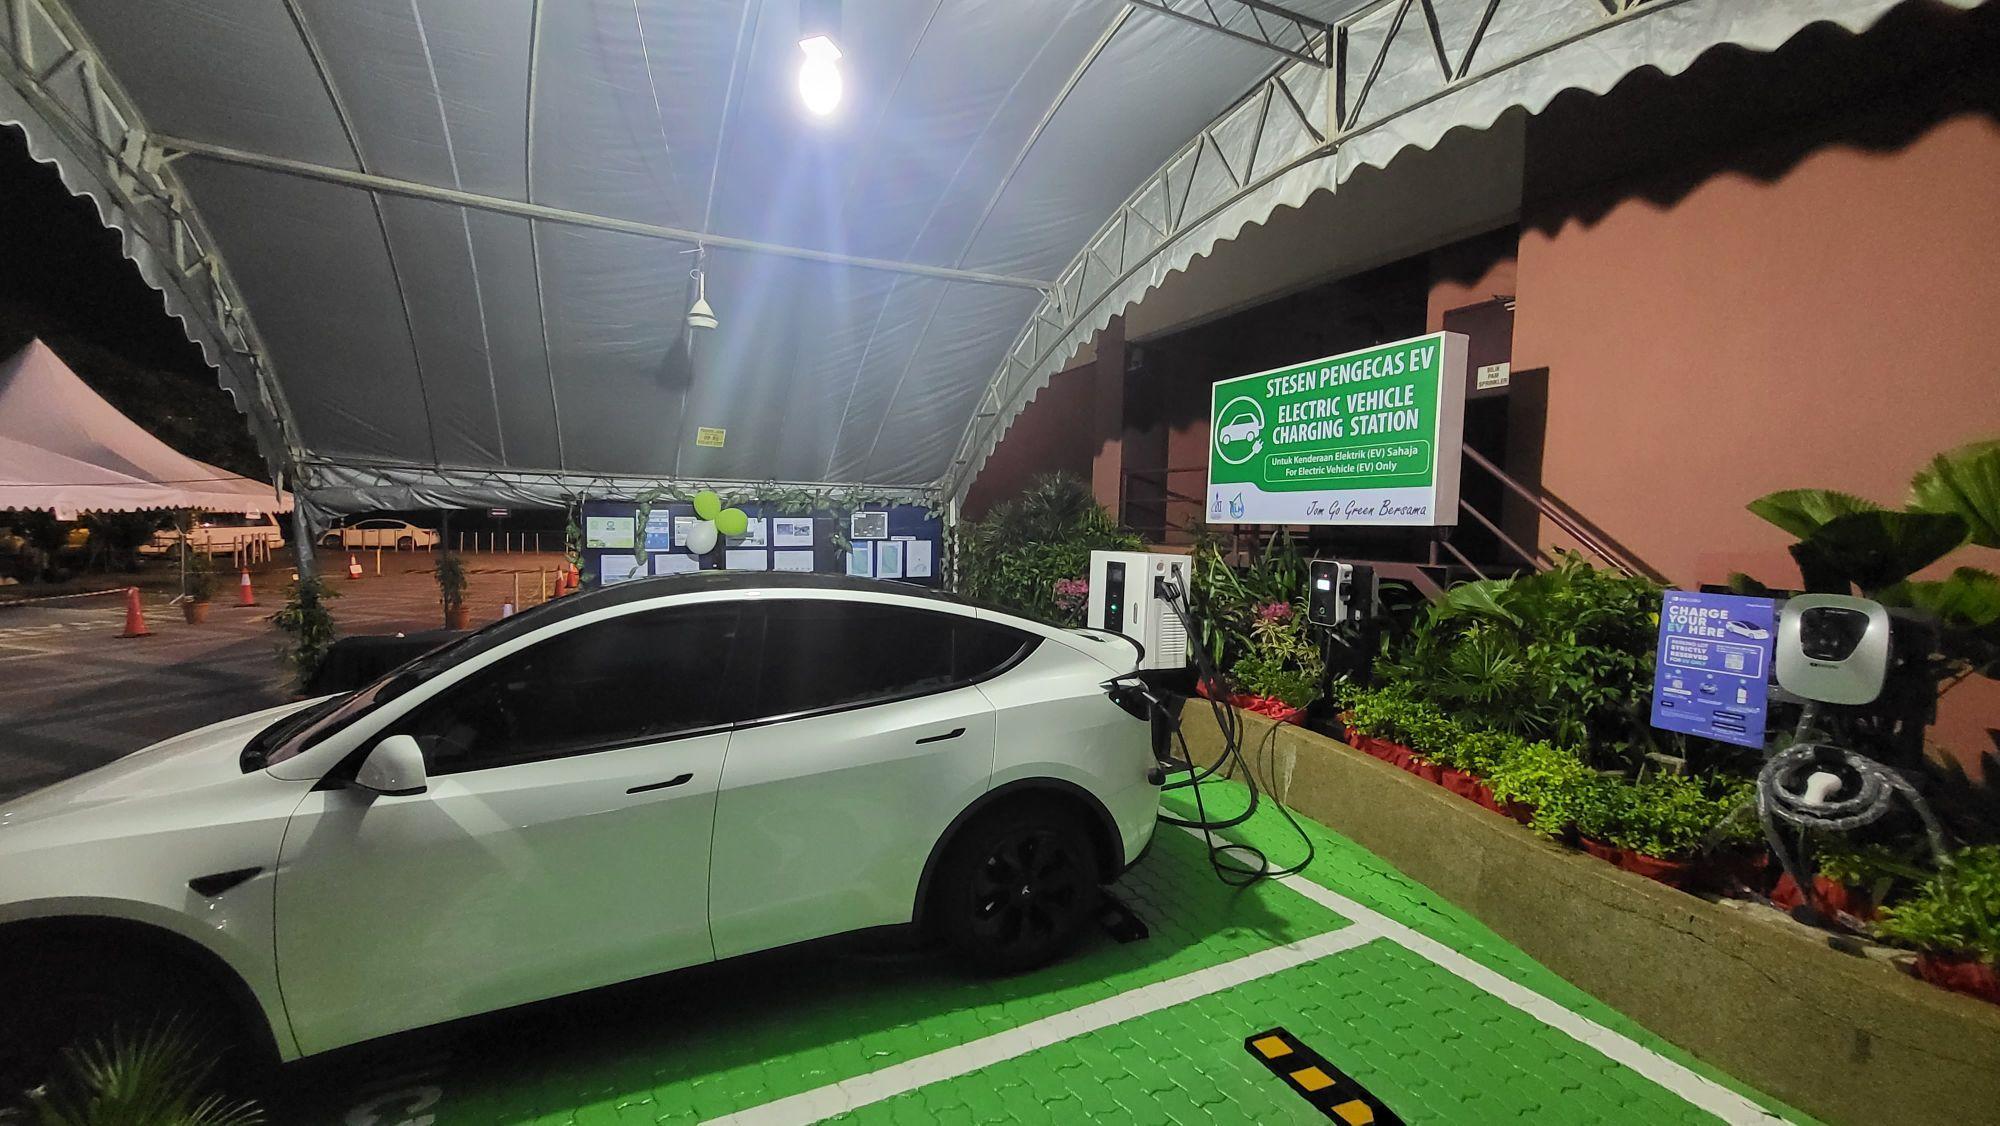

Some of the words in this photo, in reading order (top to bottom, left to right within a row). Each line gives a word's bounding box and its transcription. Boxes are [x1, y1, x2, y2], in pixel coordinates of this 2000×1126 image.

[1266, 370, 1316, 398] STESEN
[1320, 352, 1405, 388] PENGECAS
[1410, 346, 1435, 372] EV
[1278, 397, 1341, 424] ELECTRIC
[1347, 384, 1415, 414] VEHICLE
[1272, 418, 1343, 445] CHARGING
[1350, 408, 1419, 436] STATION
[1272, 457, 1293, 466] Untuk
[1294, 453, 1333, 464] Kenderaan
[1335, 450, 1365, 461] Elektrik
[1367, 447, 1385, 459] (EV)
[1387, 445, 1418, 457] Sahaja
[1285, 468, 1297, 477] For
[1298, 465, 1325, 476] Electric
[1326, 464, 1355, 474] Vehicle
[1356, 462, 1374, 473] (EV)
[1376, 461, 1397, 472] Only
[1306, 500, 1324, 516] Jom
[1328, 500, 1341, 520] Go
[1344, 500, 1375, 520] Green
[1379, 500, 1427, 516] Bersama
[1668, 614, 1707, 627] YOUR
[1669, 605, 1729, 620] CHARGE
[1667, 622, 1684, 633] EV
[1688, 625, 1725, 638] HERE
[1670, 651, 1709, 661] RESERVED
[1671, 644, 1708, 654] STRICTLY
